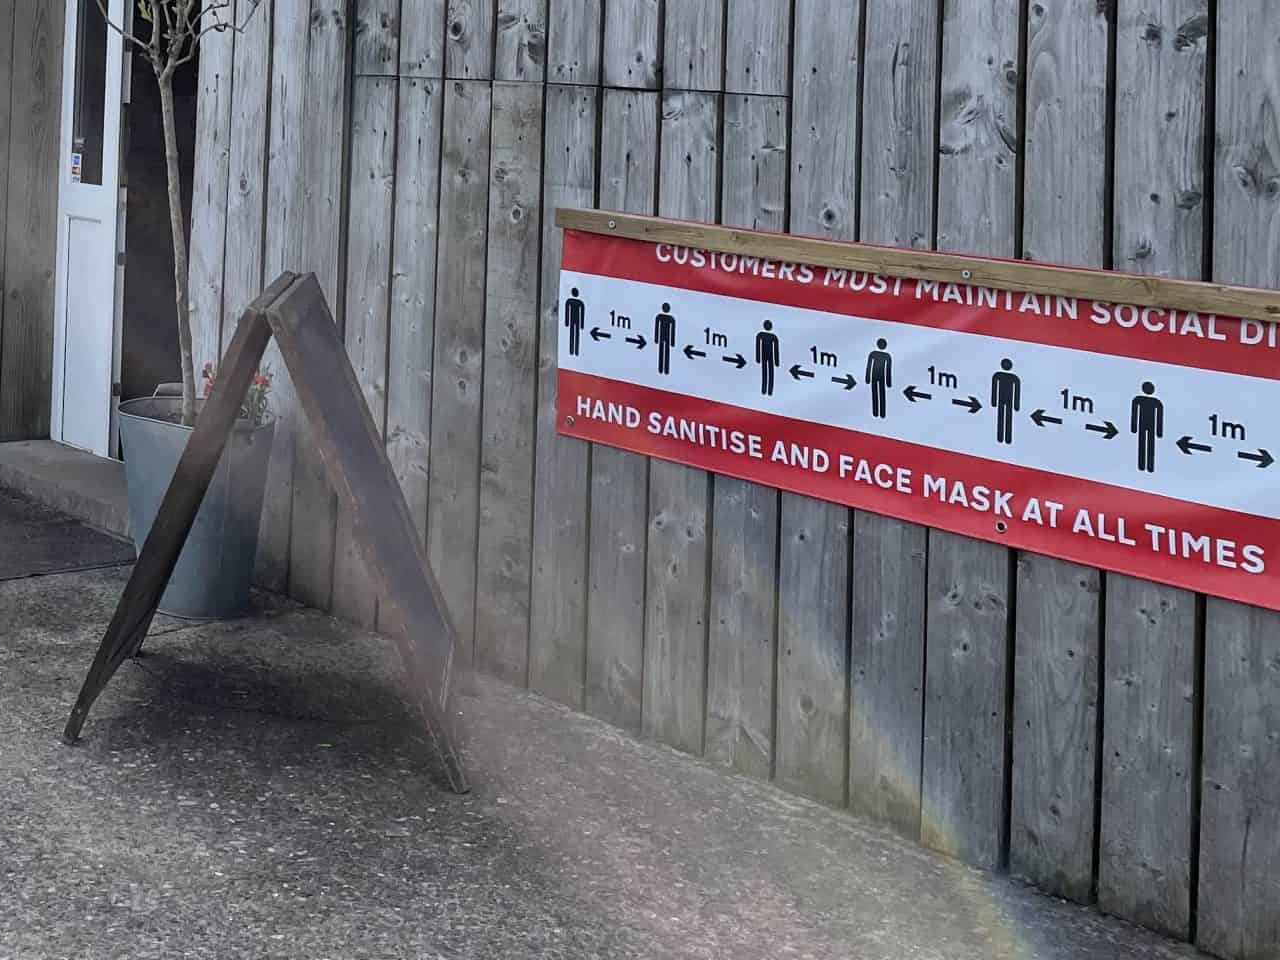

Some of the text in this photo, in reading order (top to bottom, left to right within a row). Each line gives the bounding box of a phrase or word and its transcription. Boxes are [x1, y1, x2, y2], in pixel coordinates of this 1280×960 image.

[655, 243, 814, 284] CUSTOMERS
[823, 267, 902, 297] MUST
[914, 279, 1079, 320] MAINTAIN
[1090, 301, 1227, 341] SOCIAL
[609, 310, 1246, 441] 1m 1m 1m 1m 1m 1m
[577, 395, 1266, 574] HAND SANITISE AND FACE MASK AT ALL TIMES
